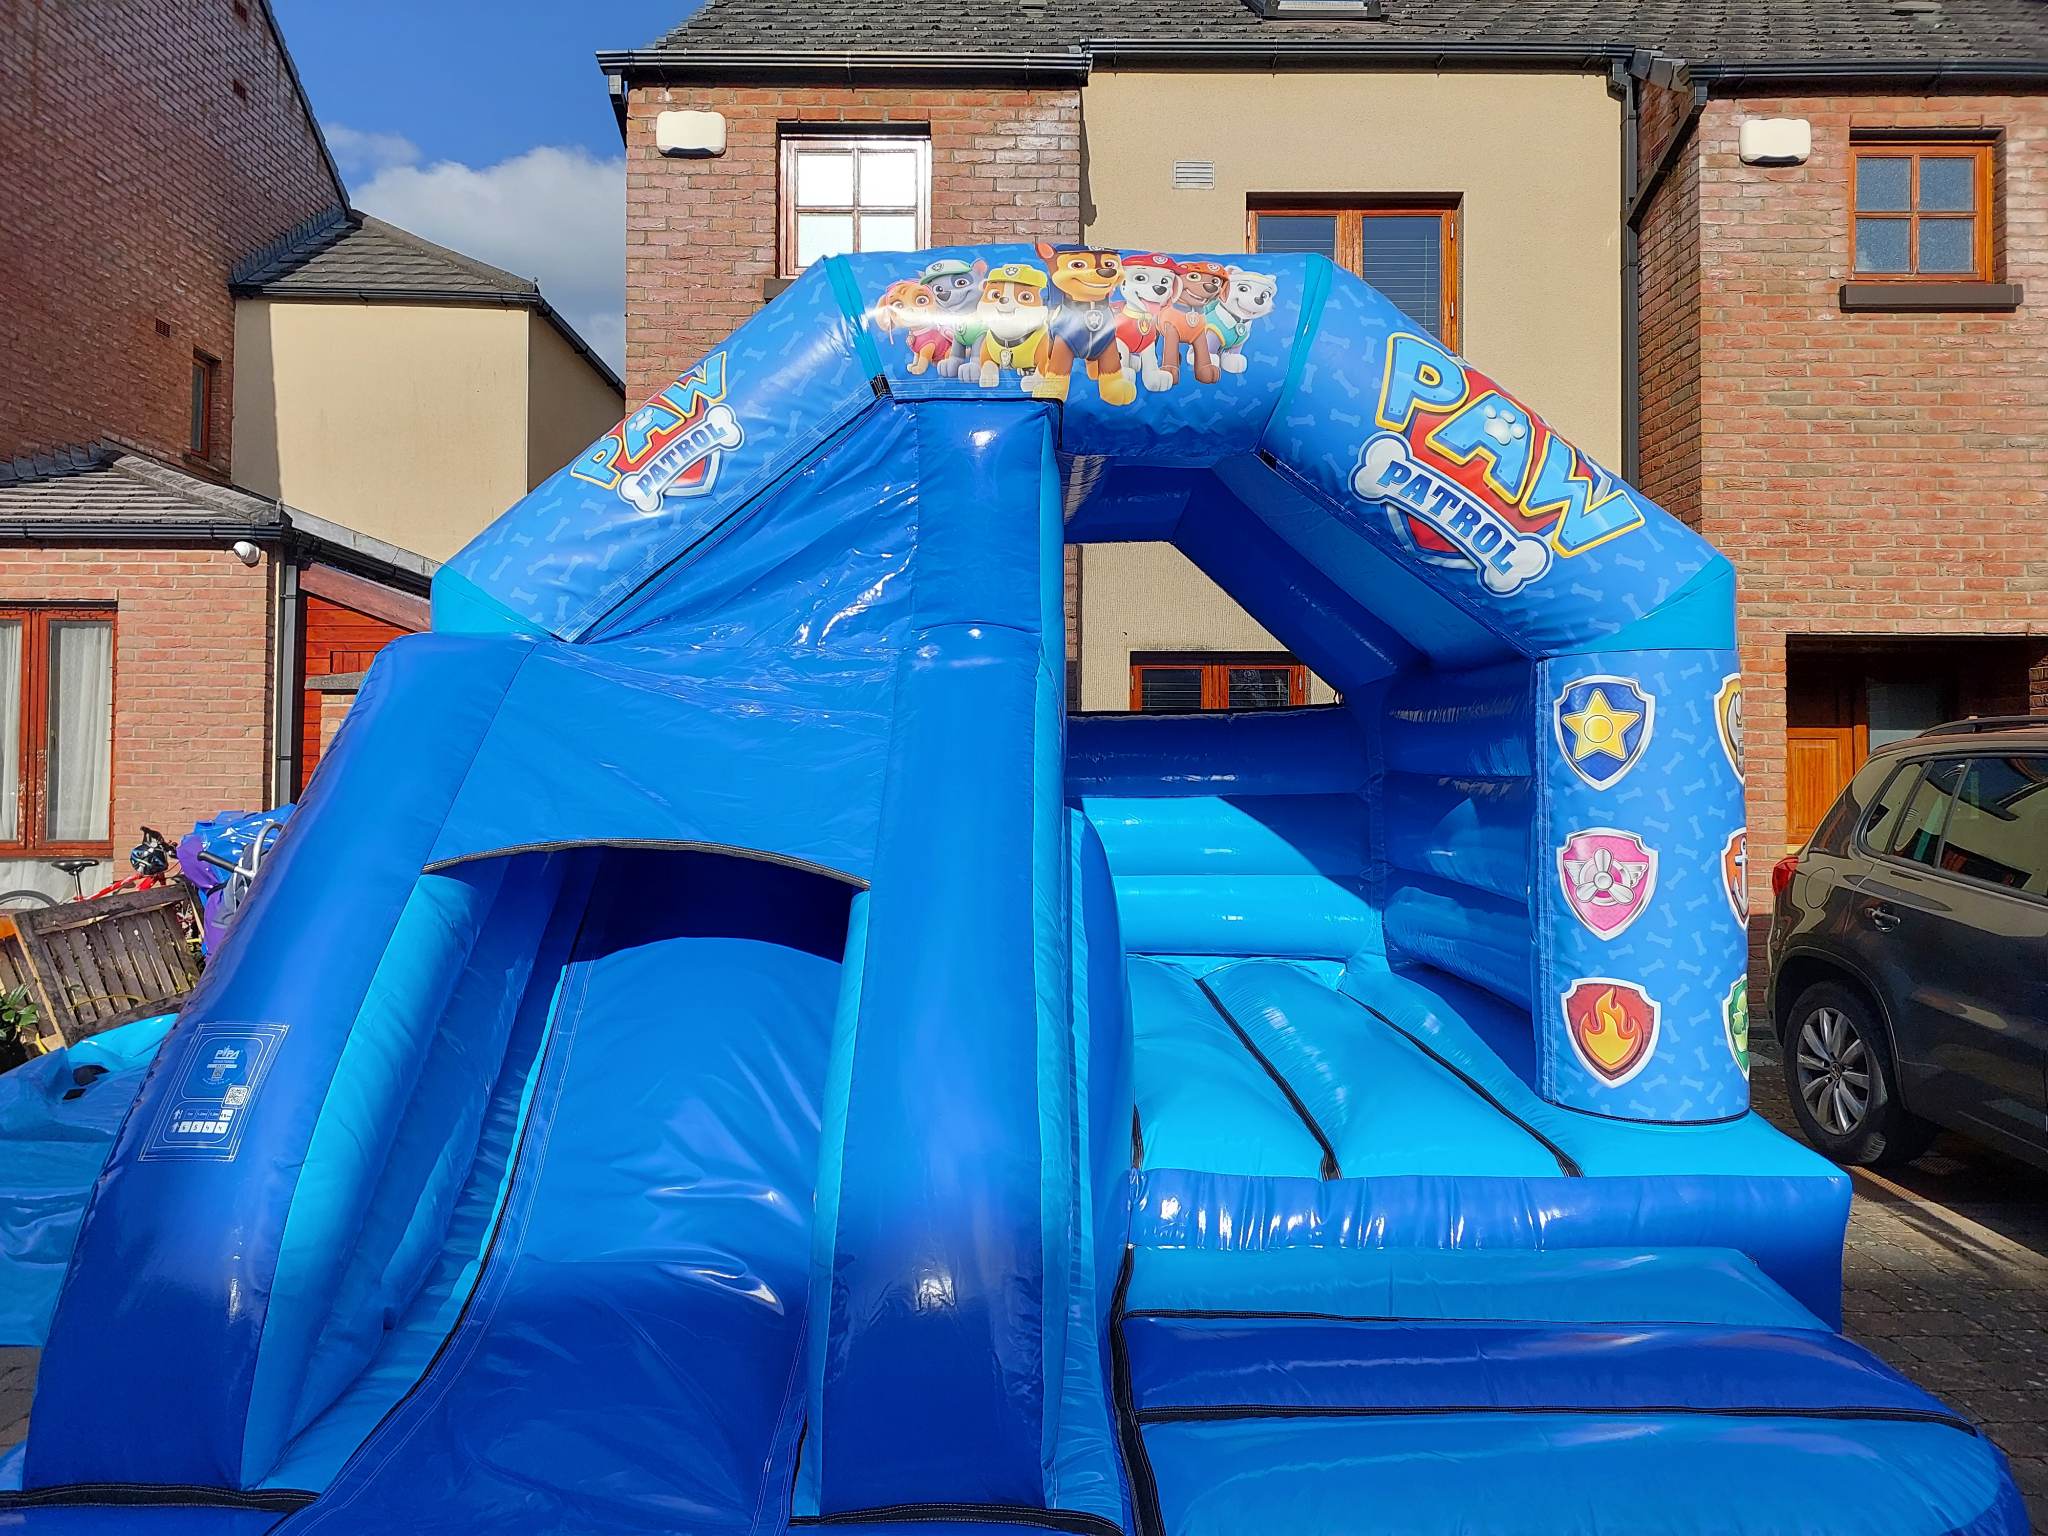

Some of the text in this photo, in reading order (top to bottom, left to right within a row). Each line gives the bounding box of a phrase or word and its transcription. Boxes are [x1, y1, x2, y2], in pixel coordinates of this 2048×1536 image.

[570, 351, 727, 490] PAW
[635, 422, 729, 498] PATROL
[1375, 332, 1646, 558] PAW
[1375, 459, 1521, 576] PATROL
